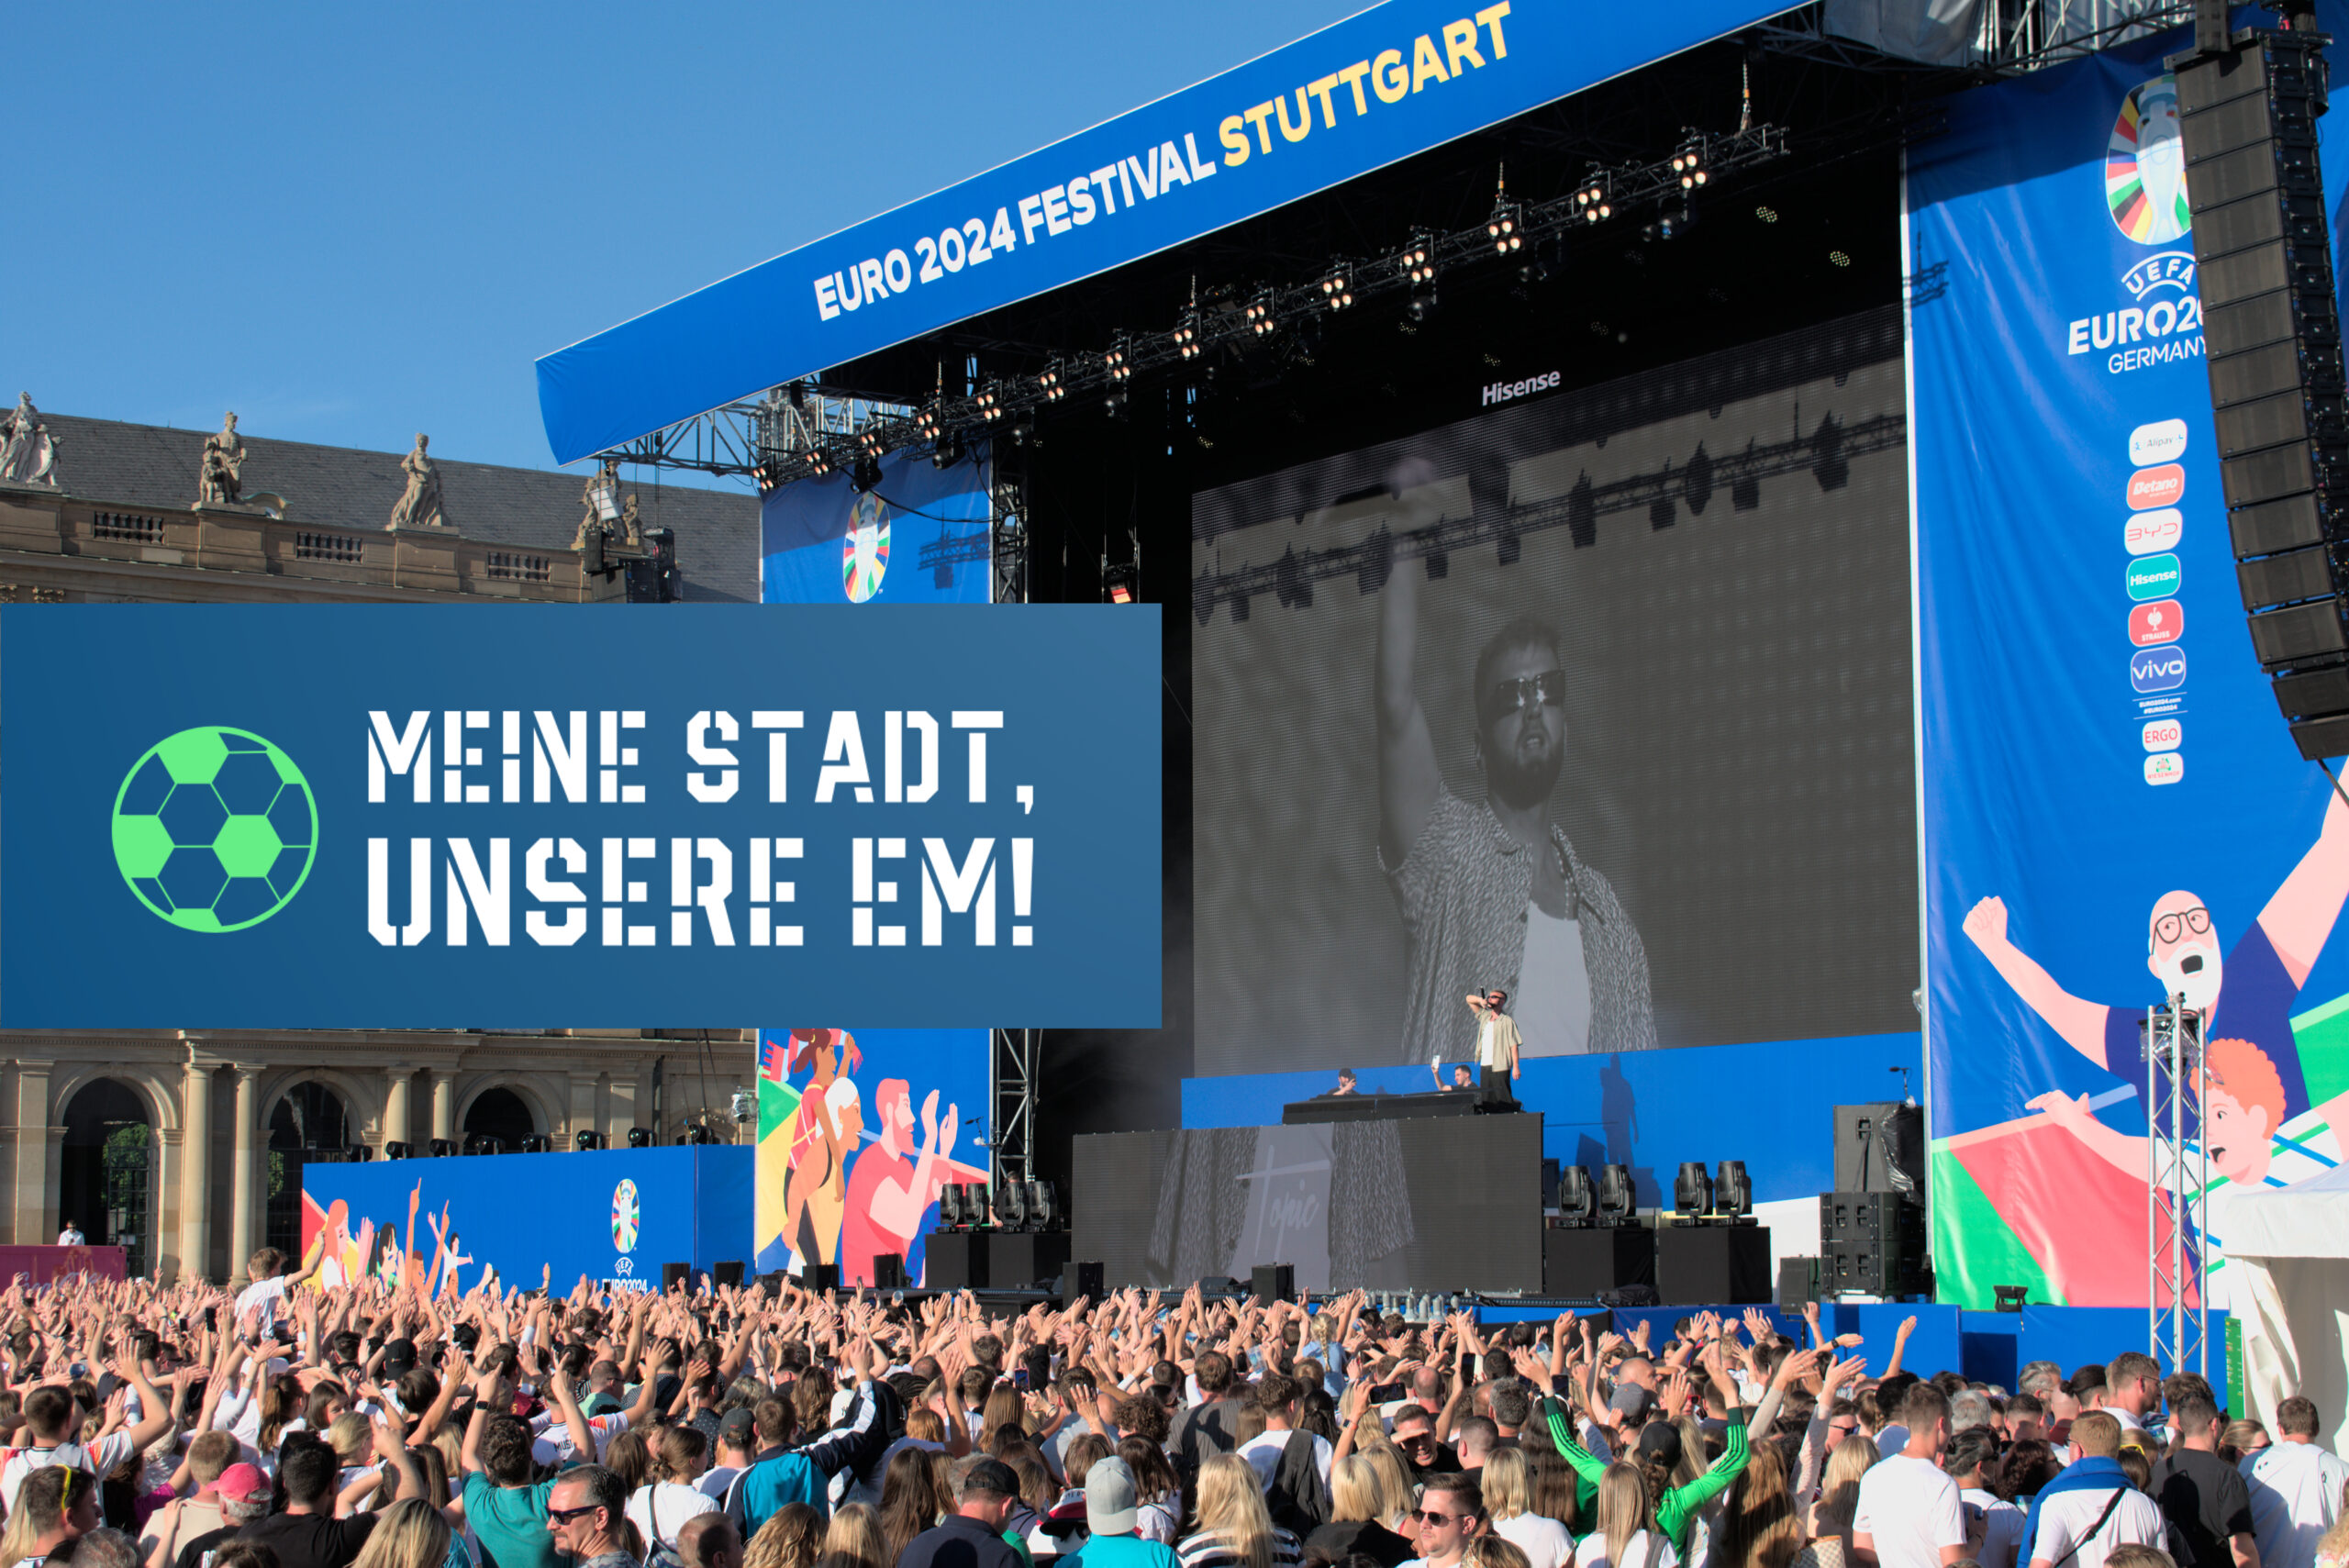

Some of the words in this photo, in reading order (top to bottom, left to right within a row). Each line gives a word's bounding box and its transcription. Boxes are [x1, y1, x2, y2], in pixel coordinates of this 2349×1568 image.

[814, 249, 912, 321] EURO
[914, 206, 1017, 284] 2024
[1018, 133, 1217, 245] FESTIVAL
[1219, 0, 1511, 167] STUTTGART
[2125, 259, 2194, 294] UEFA
[1482, 371, 1561, 406] Hisense
[2132, 478, 2177, 495] Betano
[2127, 522, 2178, 542] BYD
[2130, 570, 2177, 586] Hisense
[2142, 630, 2170, 642] STRAUSS
[2132, 660, 2184, 680] vivo
[2144, 728, 2178, 744] ERGO
[615, 1261, 633, 1274] UEFA
[553, 1439, 573, 1452] MUSI
